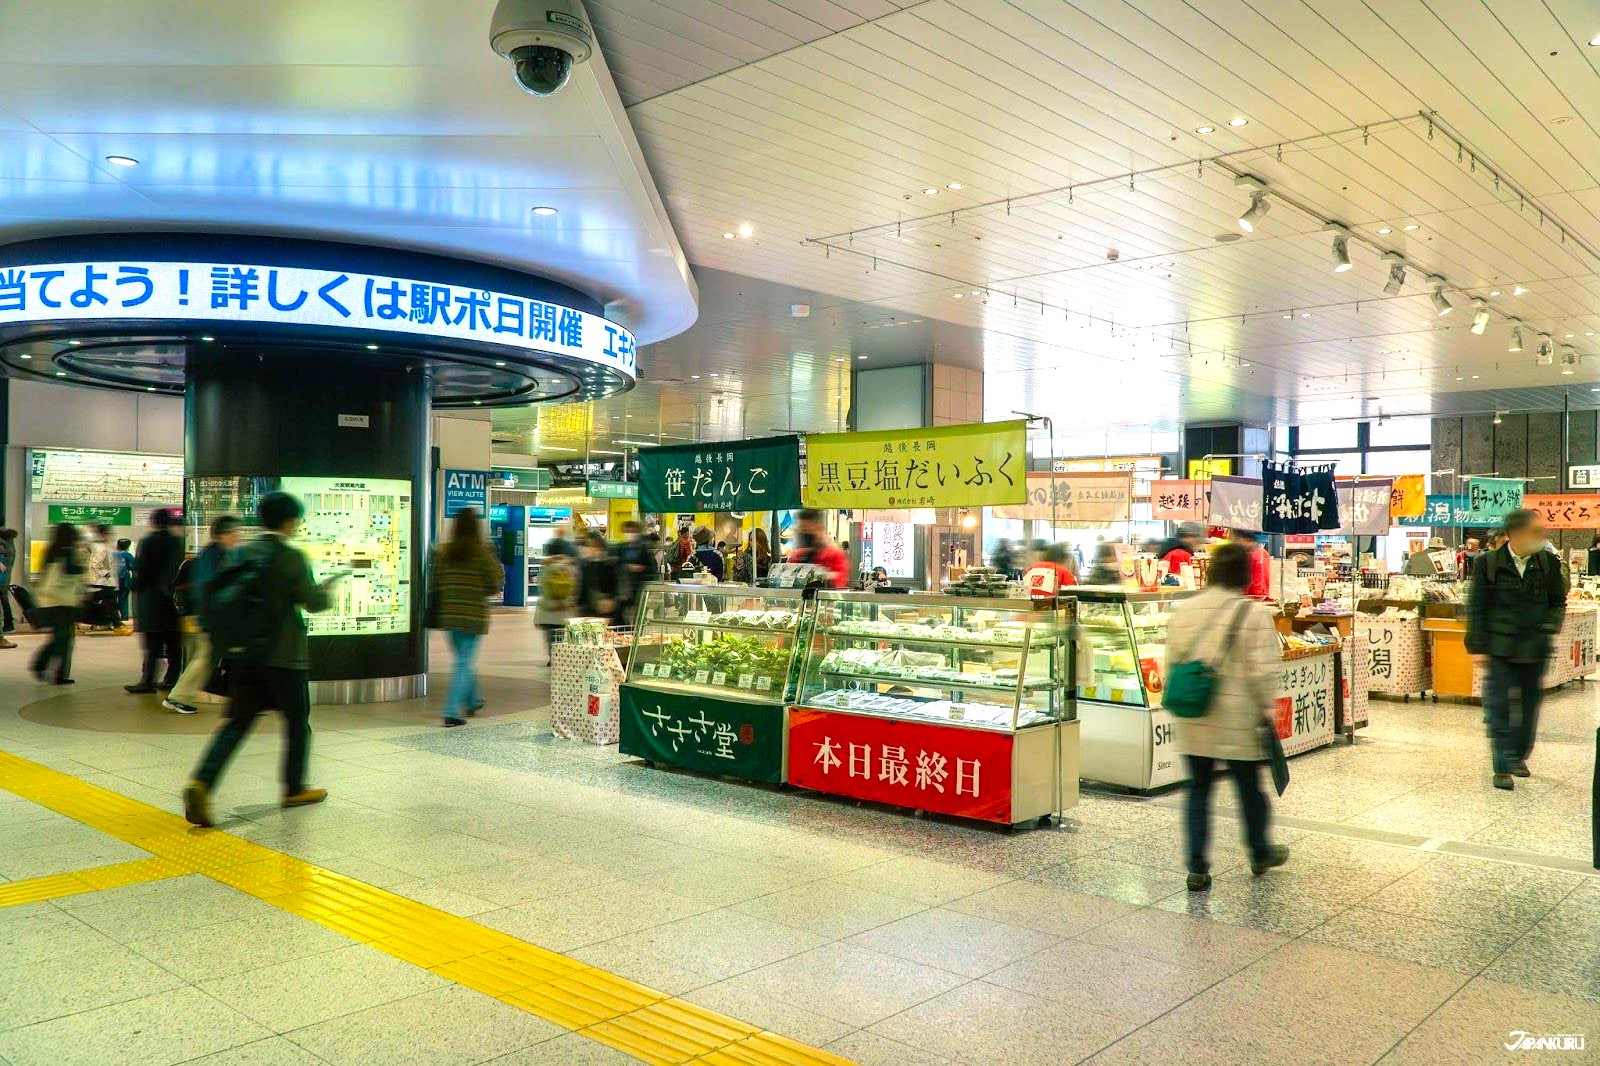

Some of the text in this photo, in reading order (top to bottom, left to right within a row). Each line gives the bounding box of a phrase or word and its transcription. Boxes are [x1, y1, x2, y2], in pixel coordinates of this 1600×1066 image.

[694, 452, 735, 464] 越後長岡
[883, 440, 936, 453] 越後長岡
[447, 472, 485, 490] ATM
[664, 466, 769, 500] 笹だんご
[817, 452, 1015, 492] 黒豆塩だいふく
[447, 489, 464, 497] VIEW
[1368, 628, 1393, 645] しり
[1367, 648, 1392, 679] 潟
[1281, 662, 1327, 692] まさぎっしり
[1294, 688, 1327, 735] 新潟
[1155, 723, 1172, 747] SH
[812, 735, 982, 798] 本日最終日
[1157, 760, 1172, 771] Since
